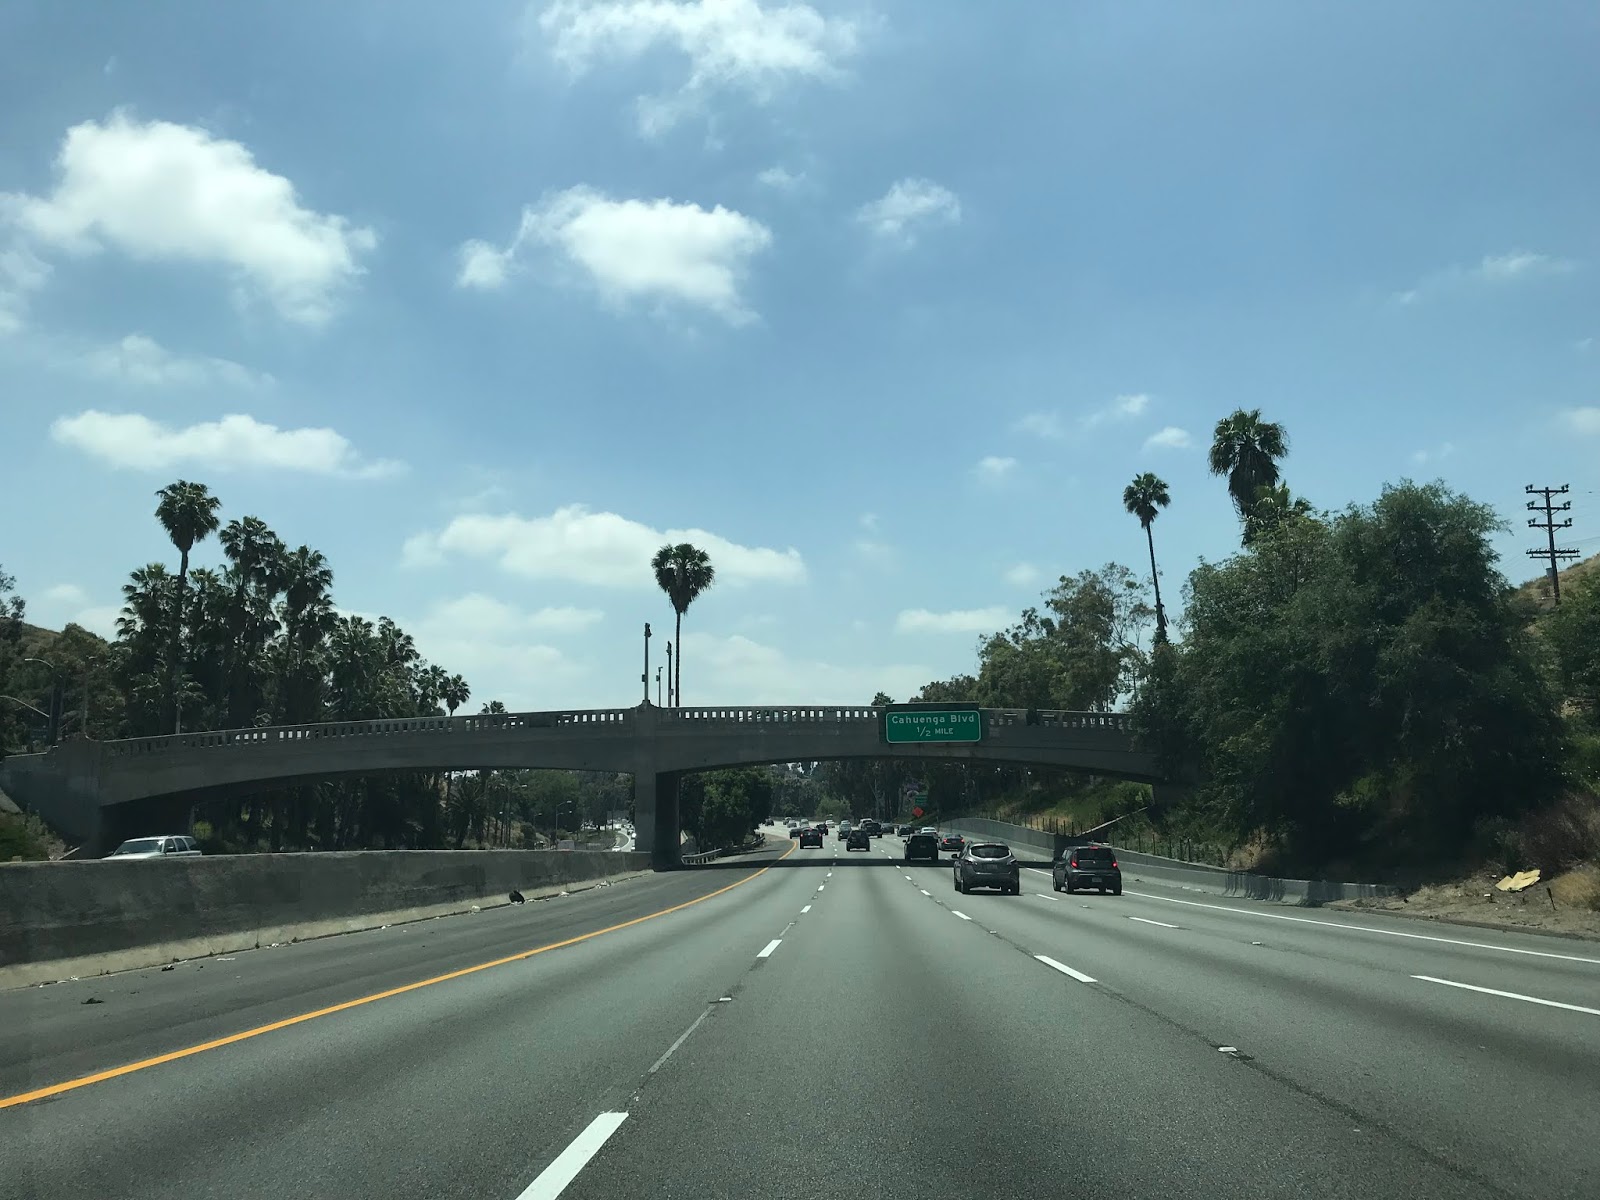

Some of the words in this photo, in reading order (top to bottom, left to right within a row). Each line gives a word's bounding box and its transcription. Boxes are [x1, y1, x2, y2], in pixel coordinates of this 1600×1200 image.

[891, 715, 945, 725] Cahuenga
[950, 714, 975, 723] Blvd
[934, 727, 954, 735] MILE
